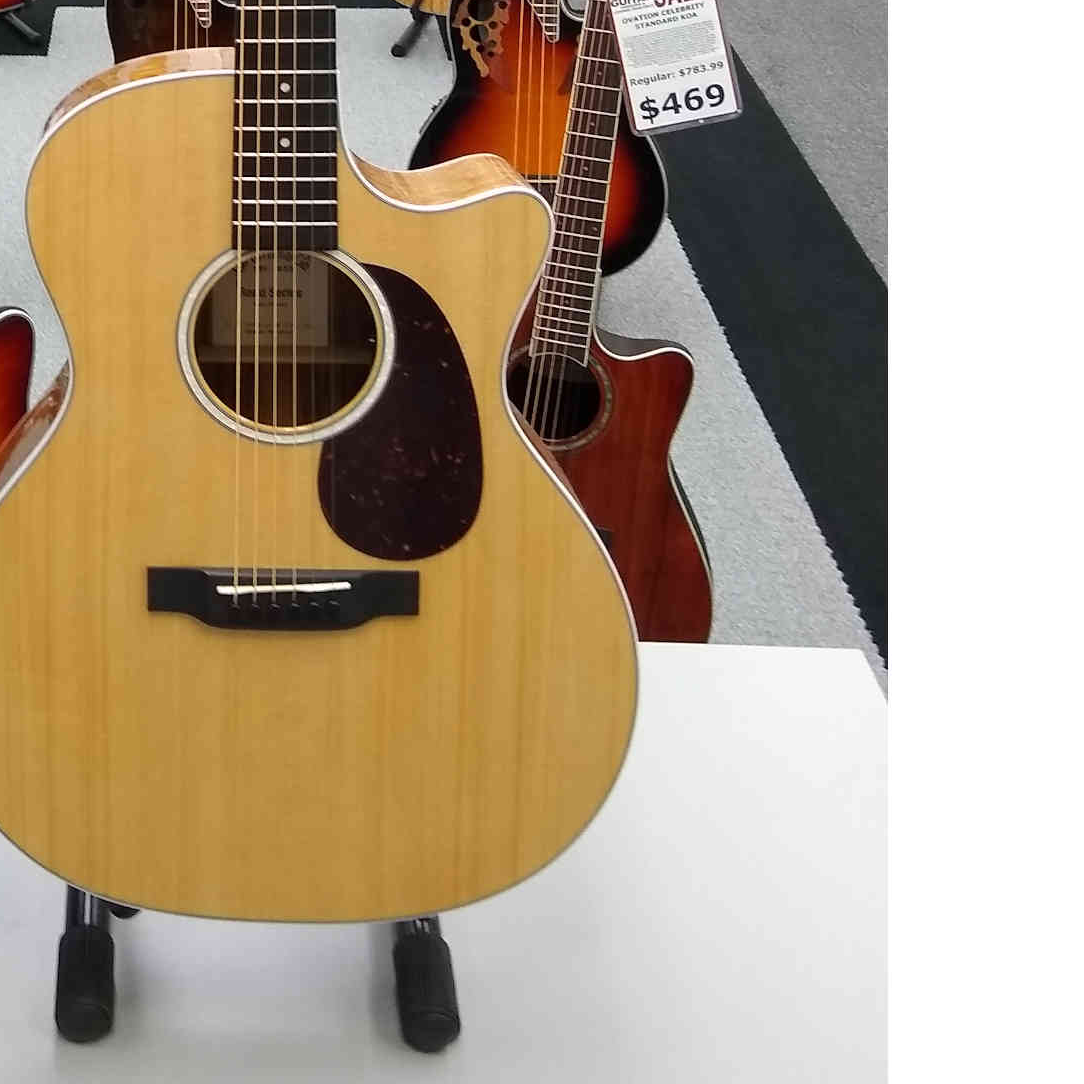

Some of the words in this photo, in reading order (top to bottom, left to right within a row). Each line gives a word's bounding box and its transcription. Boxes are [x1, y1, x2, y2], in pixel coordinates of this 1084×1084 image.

[622, 10, 659, 24] OVATION
[661, 2, 705, 16] CELEBRITY
[629, 71, 676, 87] Regular:
[679, 61, 724, 78] $783.99
[639, 83, 725, 125] $469
